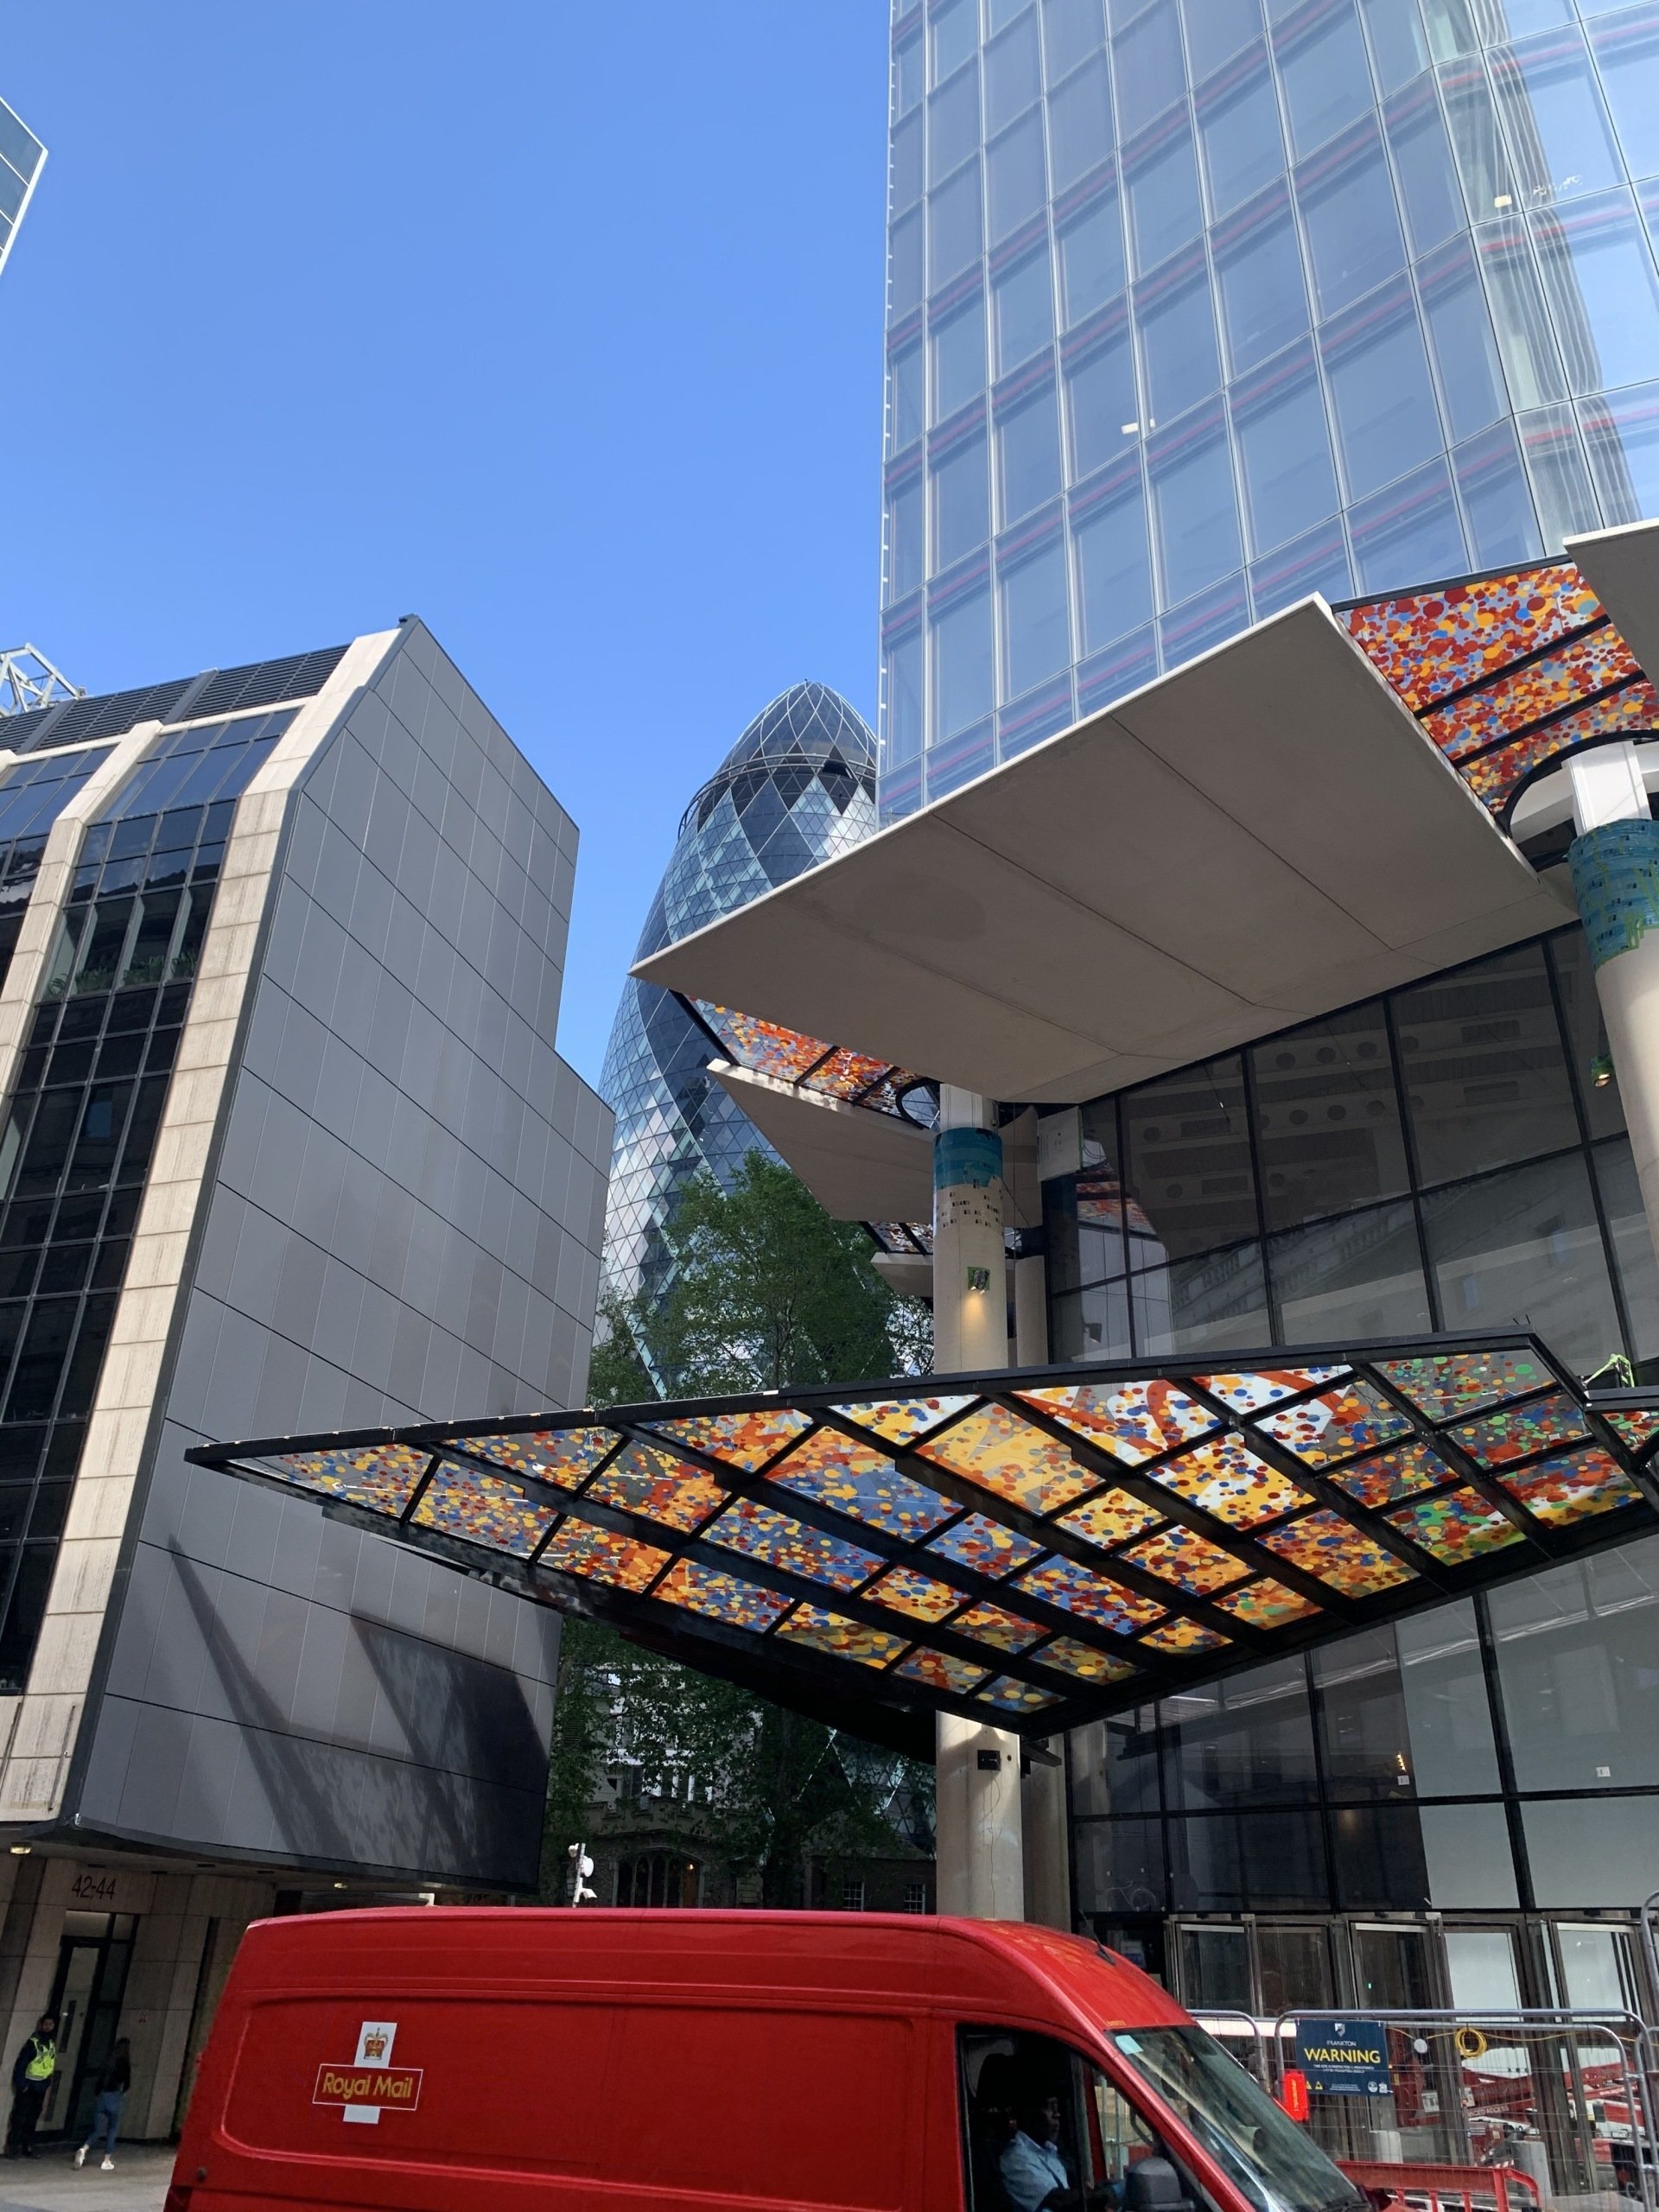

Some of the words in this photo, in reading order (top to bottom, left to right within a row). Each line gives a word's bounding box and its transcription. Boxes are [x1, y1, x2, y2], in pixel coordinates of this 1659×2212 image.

[72, 1875, 116, 1899] 42-44
[1304, 2048, 1381, 2063] WARNING
[322, 2072, 372, 2100] Royal
[372, 2075, 413, 2098] Mail
